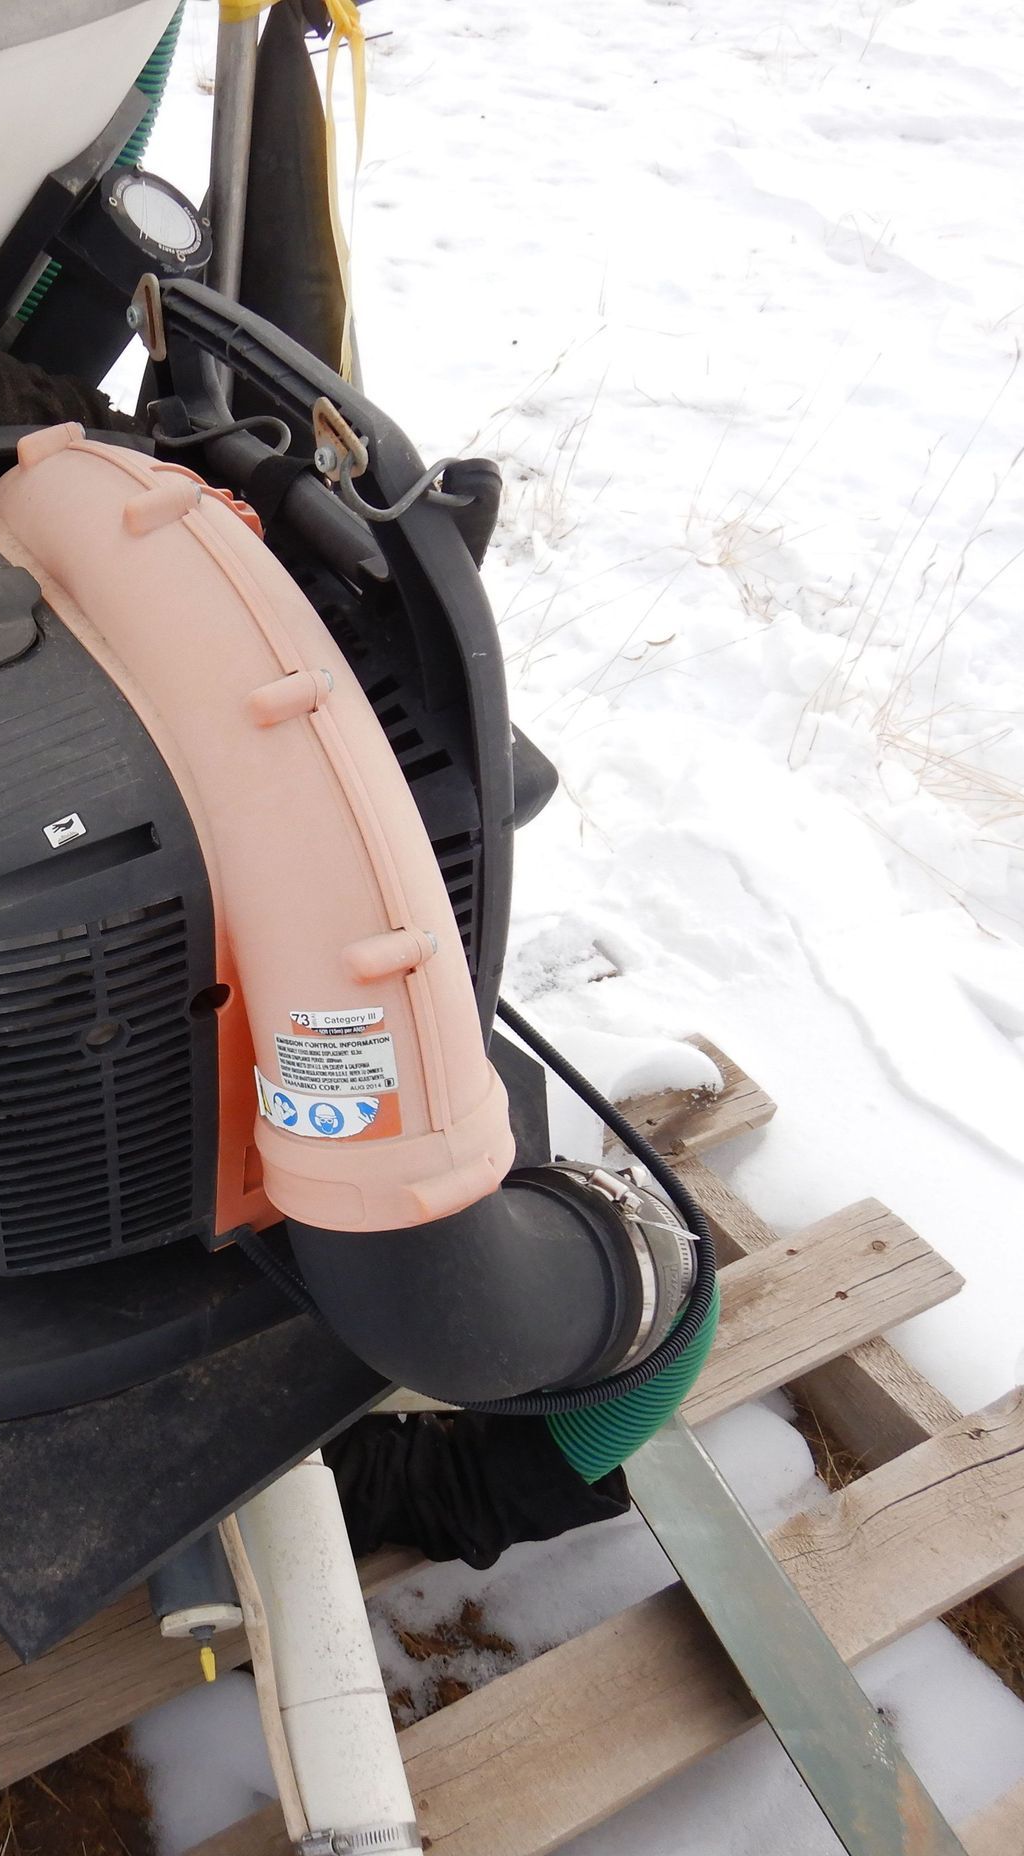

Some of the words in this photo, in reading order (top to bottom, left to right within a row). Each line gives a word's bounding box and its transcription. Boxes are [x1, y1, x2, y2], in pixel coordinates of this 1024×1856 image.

[324, 1015, 365, 1025] Category
[367, 1012, 376, 1020] III
[276, 1036, 303, 1048] EMISSION
[305, 1041, 337, 1049] CONTROL
[339, 1036, 390, 1048] INFORMATION
[284, 1078, 316, 1090] YAMABIKO
